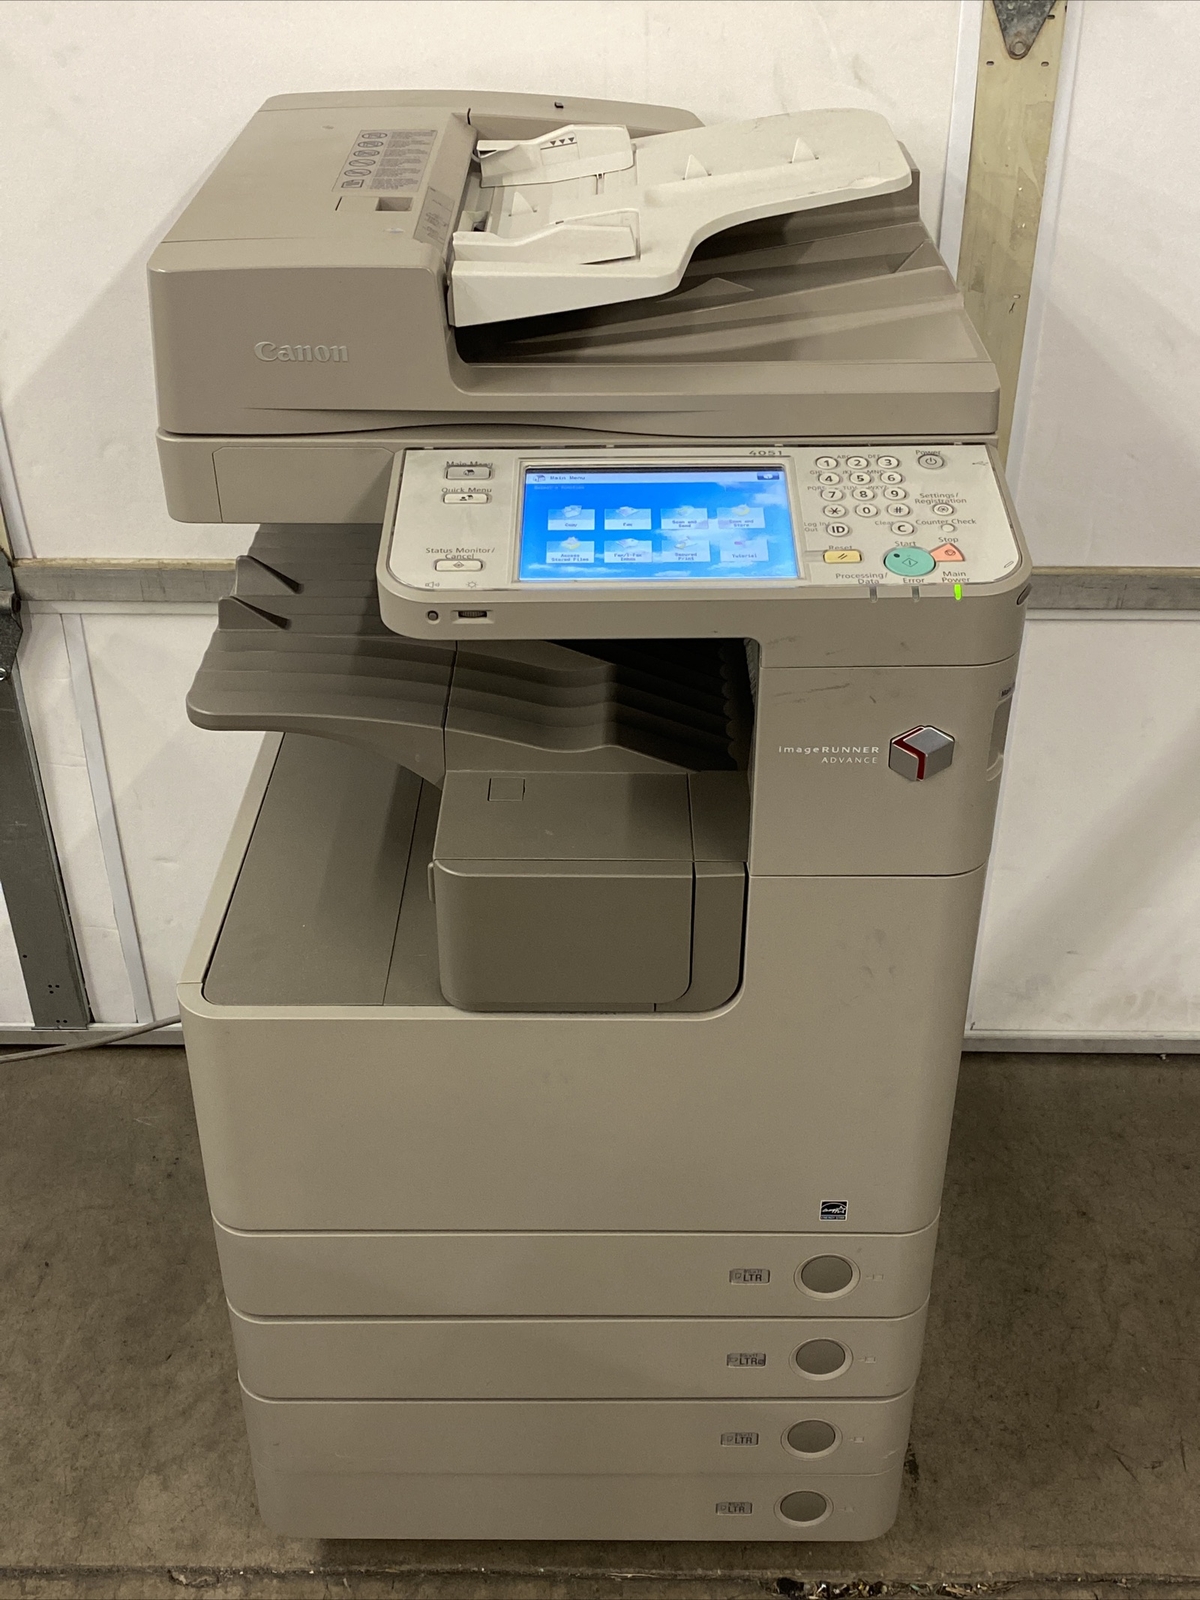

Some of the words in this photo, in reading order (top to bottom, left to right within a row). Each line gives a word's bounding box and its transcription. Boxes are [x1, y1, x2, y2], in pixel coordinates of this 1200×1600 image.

[253, 341, 349, 363] Canon
[832, 525, 846, 534] ID
[835, 572, 888, 580] Processing/
[778, 745, 880, 755] imageRUNNER
[821, 756, 878, 764] ADVANCE
[743, 1273, 762, 1281] LTR
